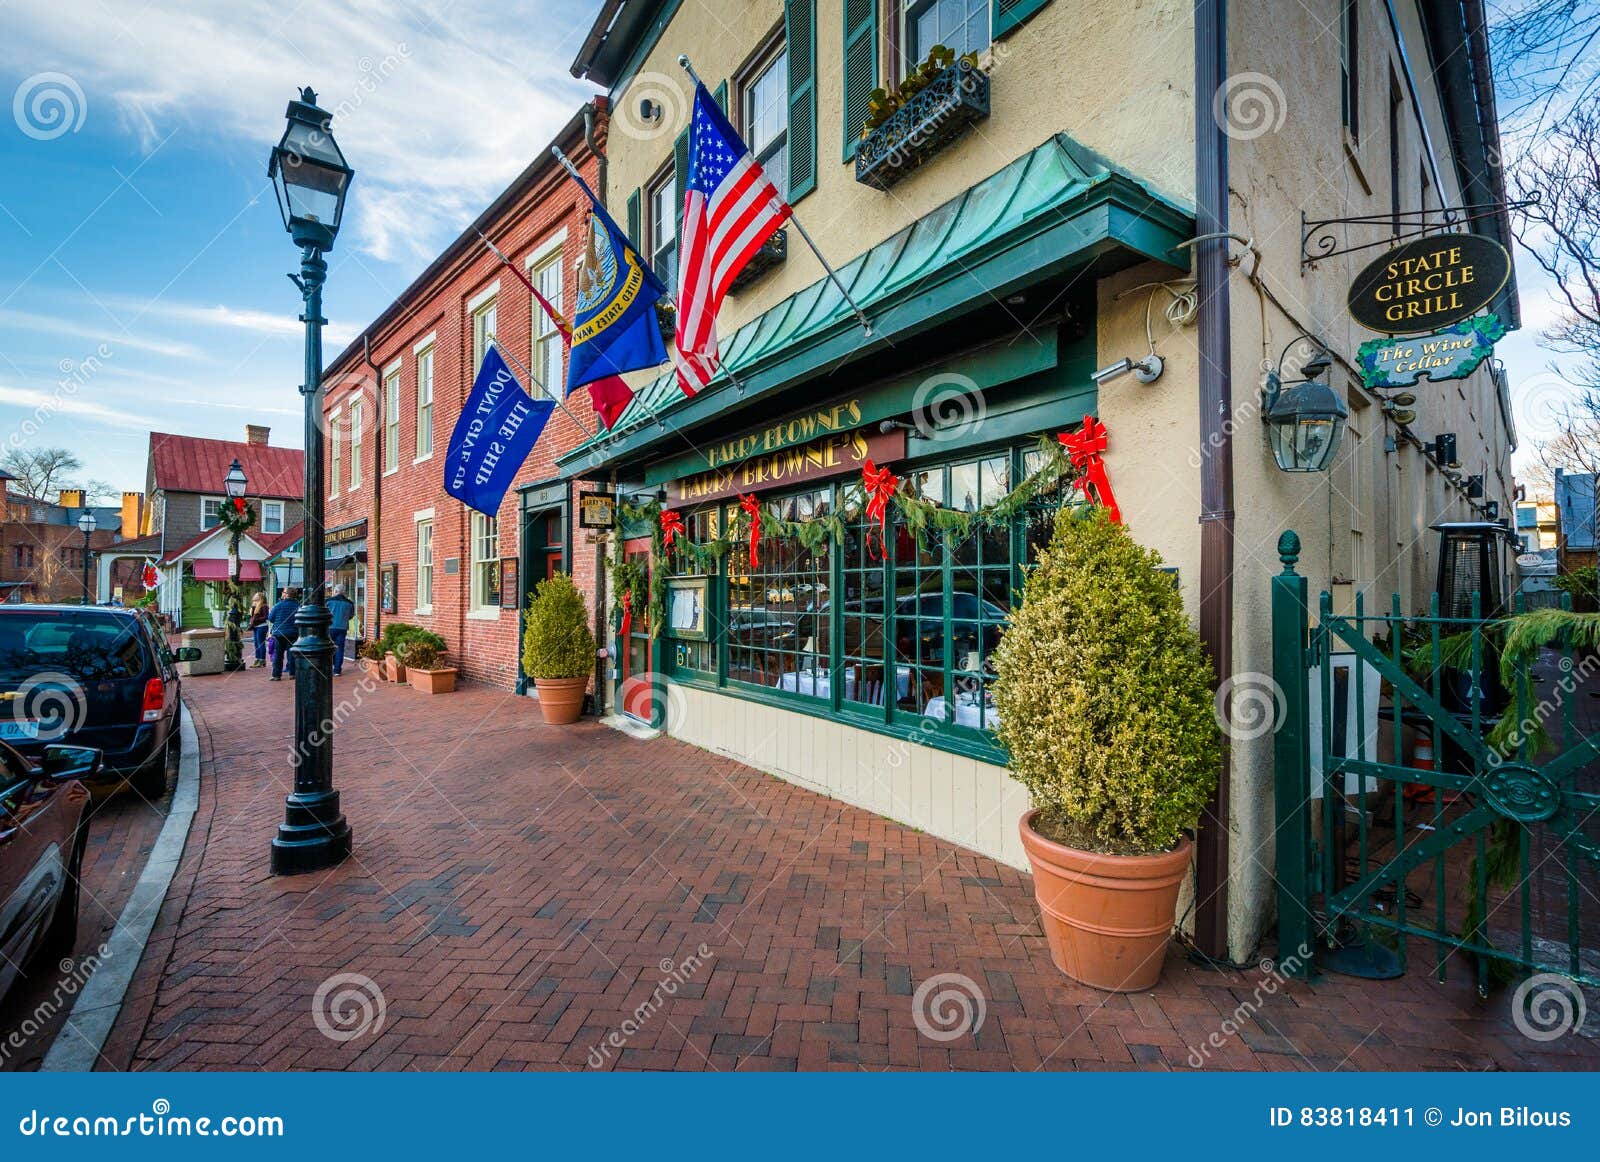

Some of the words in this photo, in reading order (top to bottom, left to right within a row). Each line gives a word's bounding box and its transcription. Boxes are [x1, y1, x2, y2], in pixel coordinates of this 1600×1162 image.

[1387, 247, 1461, 280] STATE
[1375, 265, 1474, 302] CIRCLE
[1385, 292, 1463, 321] GRILL
[1380, 345, 1413, 363] The
[1422, 337, 1473, 355] Wine
[1395, 354, 1454, 374] Cellar
[708, 435, 760, 468] HARRY
[763, 399, 862, 450] BROWNE'S
[680, 467, 735, 500] HARRY
[742, 428, 869, 487] BROWNE'S
